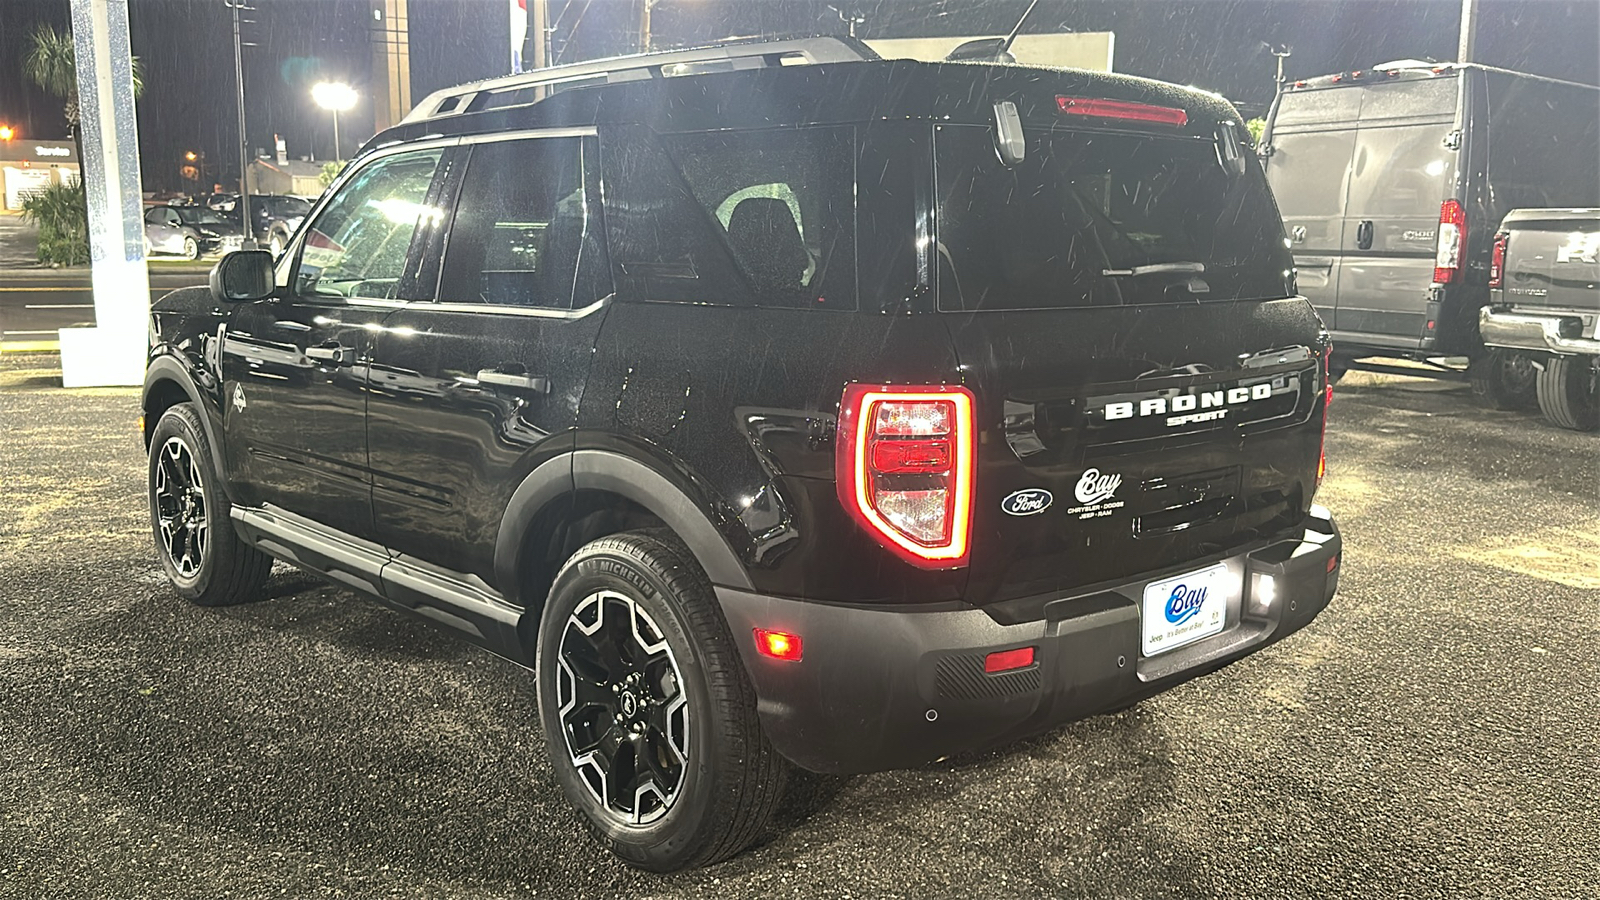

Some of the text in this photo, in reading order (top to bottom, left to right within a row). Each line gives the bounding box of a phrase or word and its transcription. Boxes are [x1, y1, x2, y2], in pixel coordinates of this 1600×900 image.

[1104, 383, 1272, 421] BRONCO
[1166, 408, 1229, 427] SPORT
[1074, 467, 1123, 505] Bay
[1011, 492, 1045, 513] Ford
[1067, 501, 1125, 515] CHRYSLER DODGE
[1079, 509, 1113, 520] JEEP RAM
[600, 561, 653, 596] MICHELIN
[1165, 583, 1209, 623] Bay
[1149, 634, 1163, 643] Jeep
